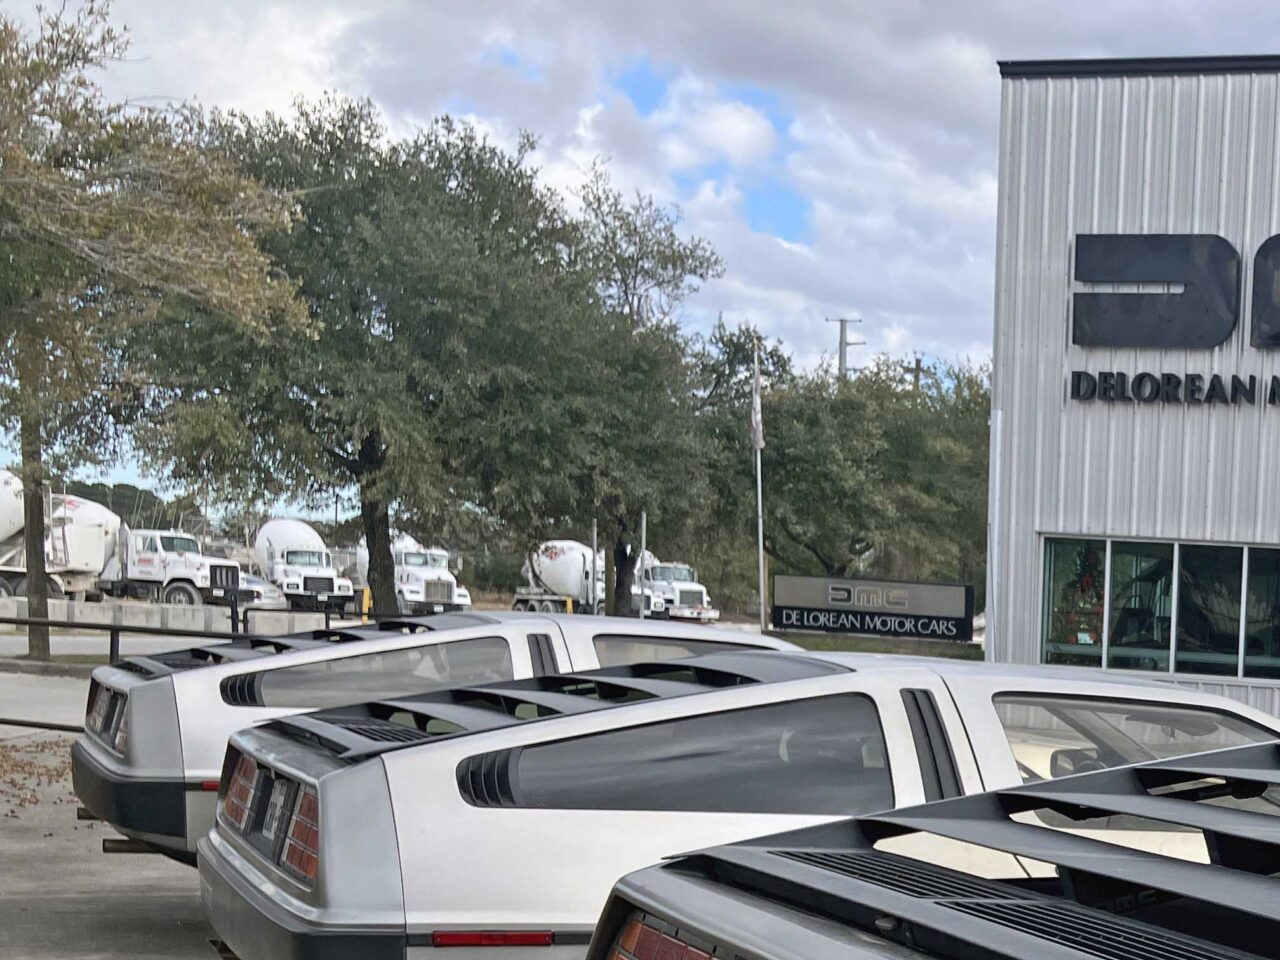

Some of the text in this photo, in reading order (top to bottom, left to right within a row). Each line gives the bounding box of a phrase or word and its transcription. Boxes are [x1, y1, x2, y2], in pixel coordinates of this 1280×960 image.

[1071, 371, 1256, 405] DELOREAN
[782, 610, 957, 636] DE LOREAN MOTOR CARS
